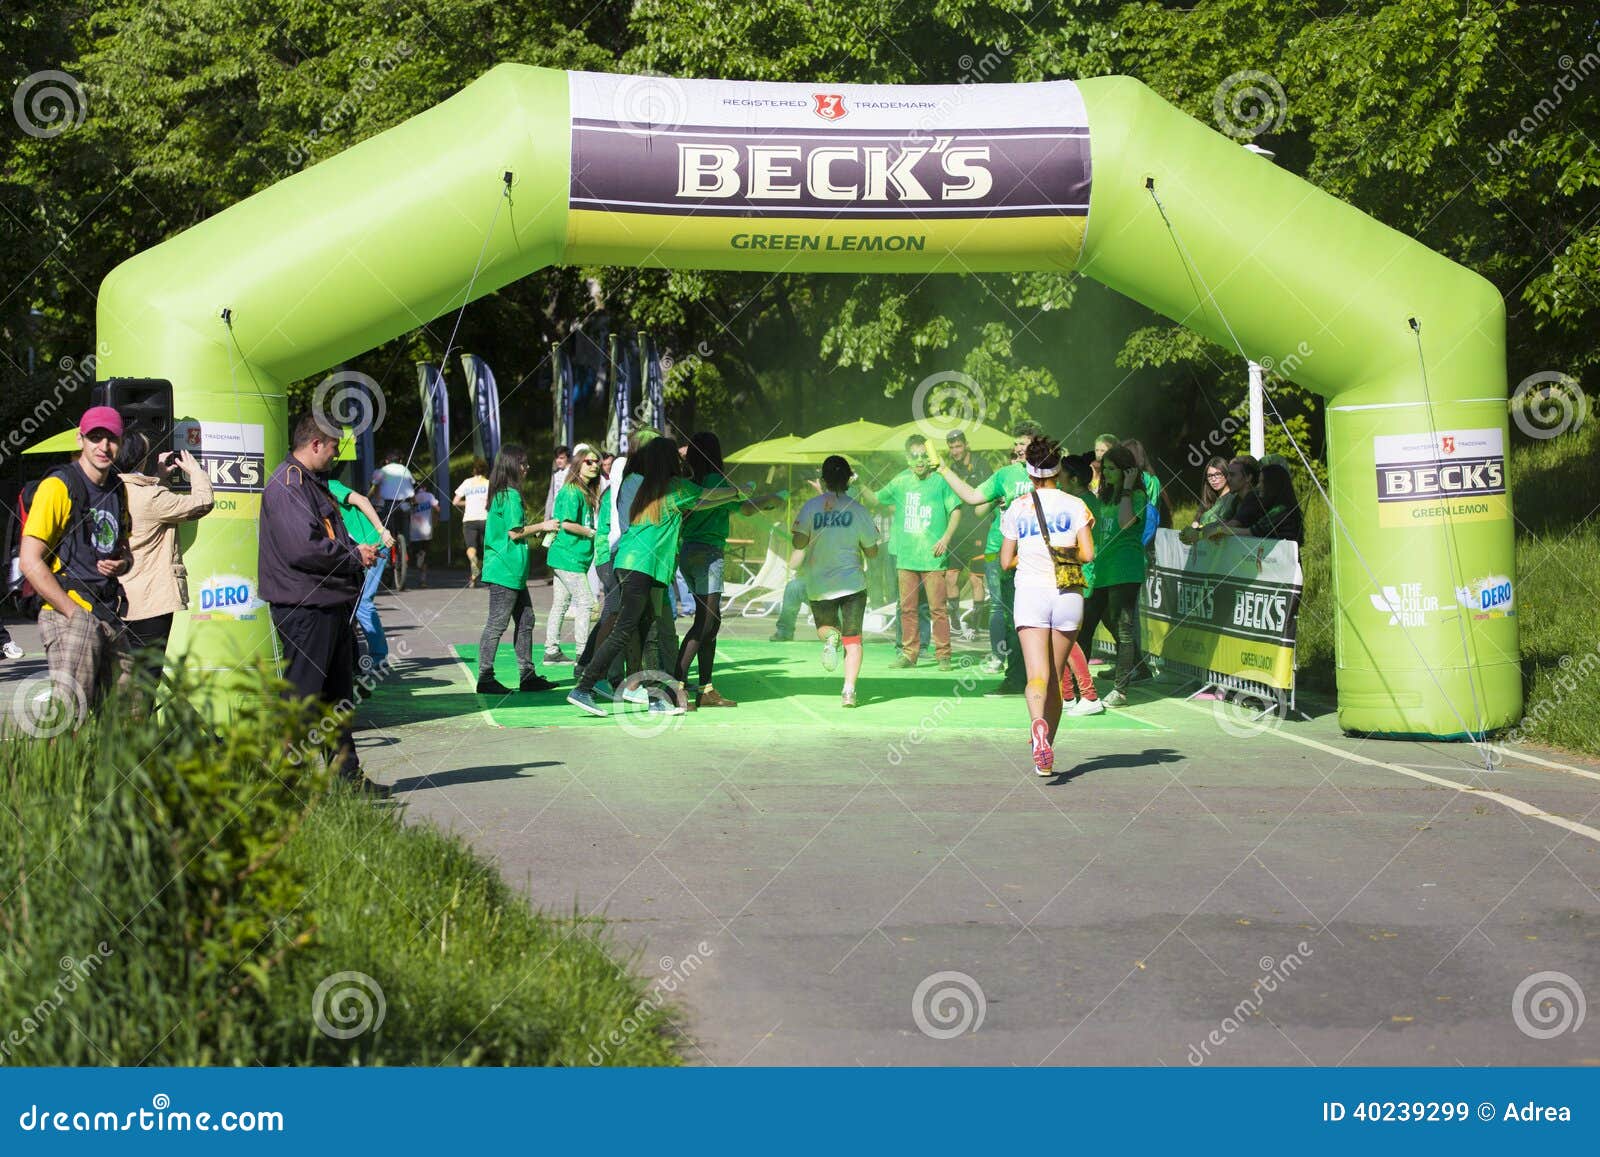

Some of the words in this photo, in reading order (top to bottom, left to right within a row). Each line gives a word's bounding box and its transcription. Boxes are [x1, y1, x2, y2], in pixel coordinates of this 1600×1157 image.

[722, 99, 808, 108] REGISTERED
[854, 101, 937, 109] TRADEMARK
[675, 136, 993, 201] BECK'S
[731, 233, 819, 250] GREEN
[825, 236, 925, 251] LEMON
[1385, 460, 1502, 494] BECK'S
[1412, 506, 1451, 518] GREEN
[1452, 503, 1489, 515] LEMON
[201, 584, 249, 609] DERO
[1401, 583, 1423, 597] THE
[1481, 581, 1512, 609] DERO
[1401, 597, 1439, 612] COLOR
[1401, 612, 1425, 627] RUN
